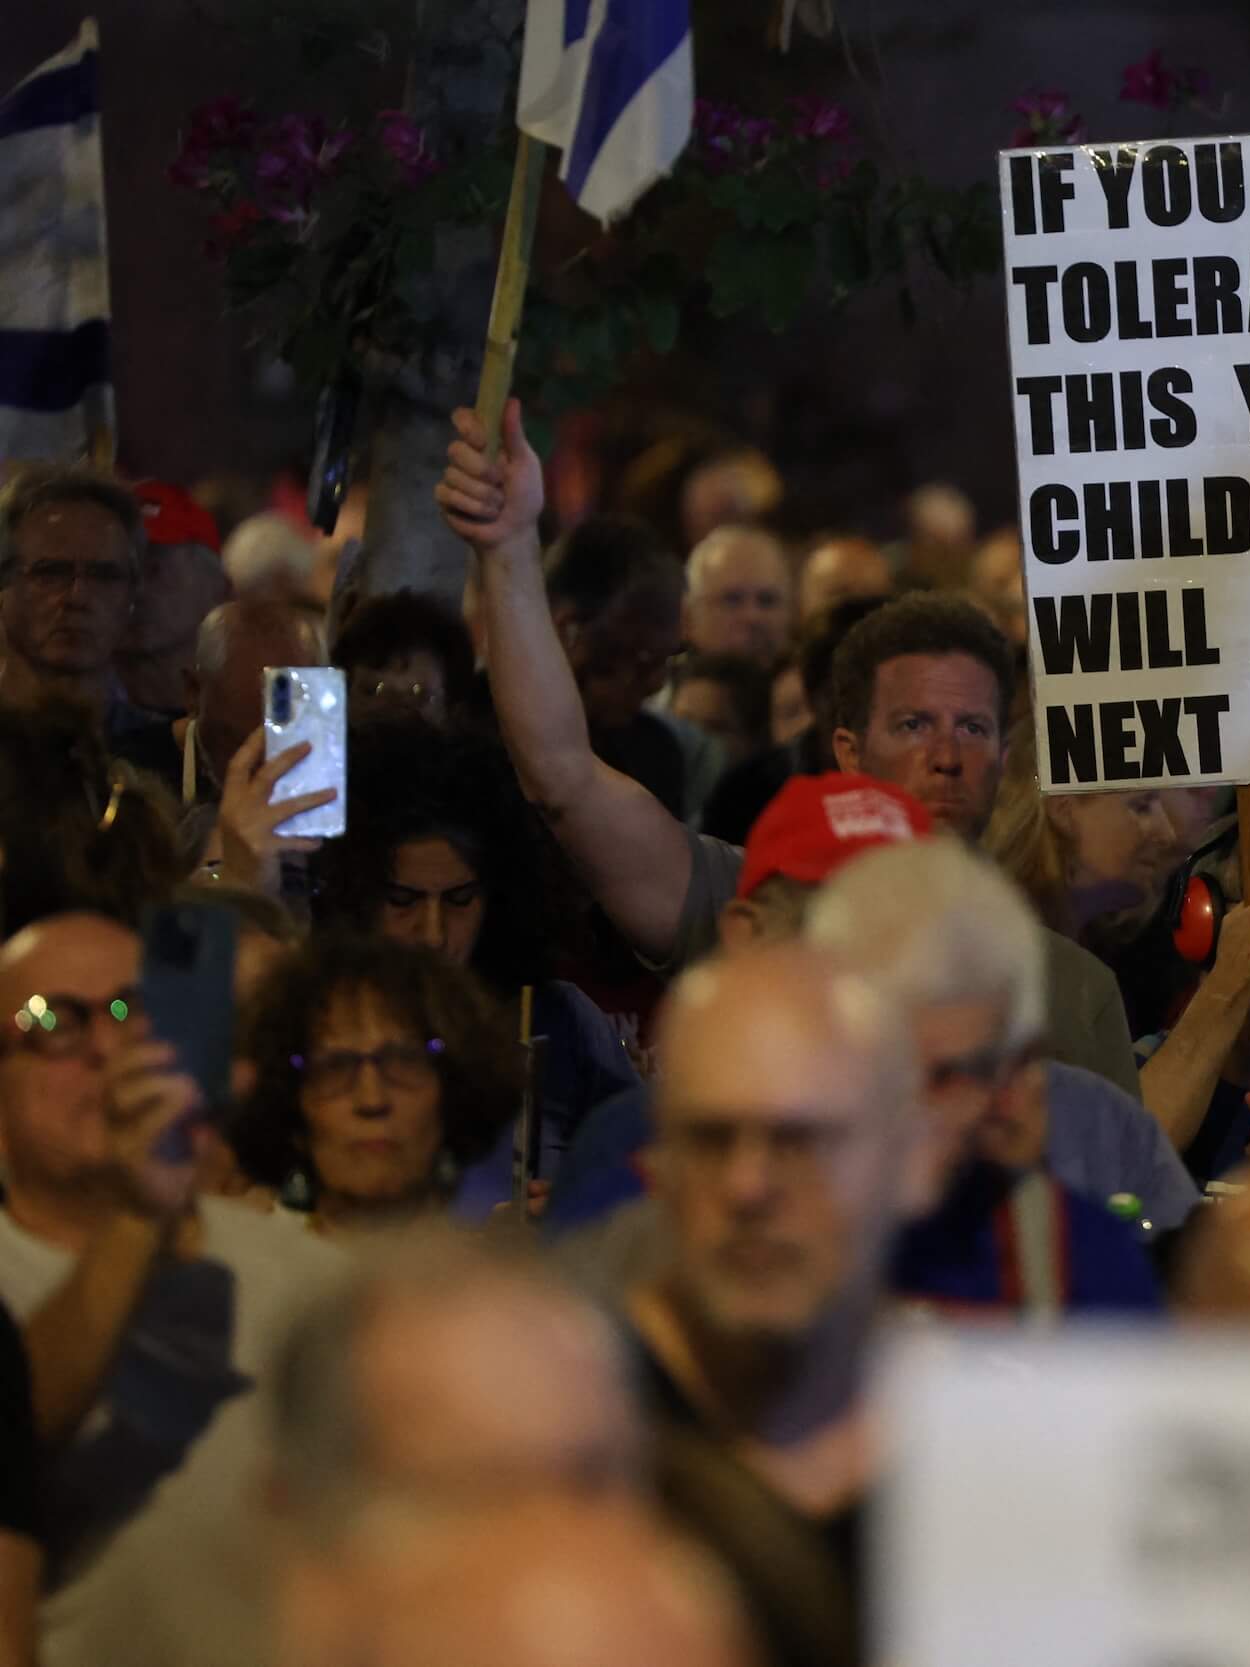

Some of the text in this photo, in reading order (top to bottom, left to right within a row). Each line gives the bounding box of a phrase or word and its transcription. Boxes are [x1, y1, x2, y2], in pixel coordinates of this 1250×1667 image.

[1009, 142, 1246, 236] IF YOU
[1016, 366, 1198, 456] THIS
[1032, 588, 1221, 676] WILL
[1045, 694, 1230, 785] NEXT
